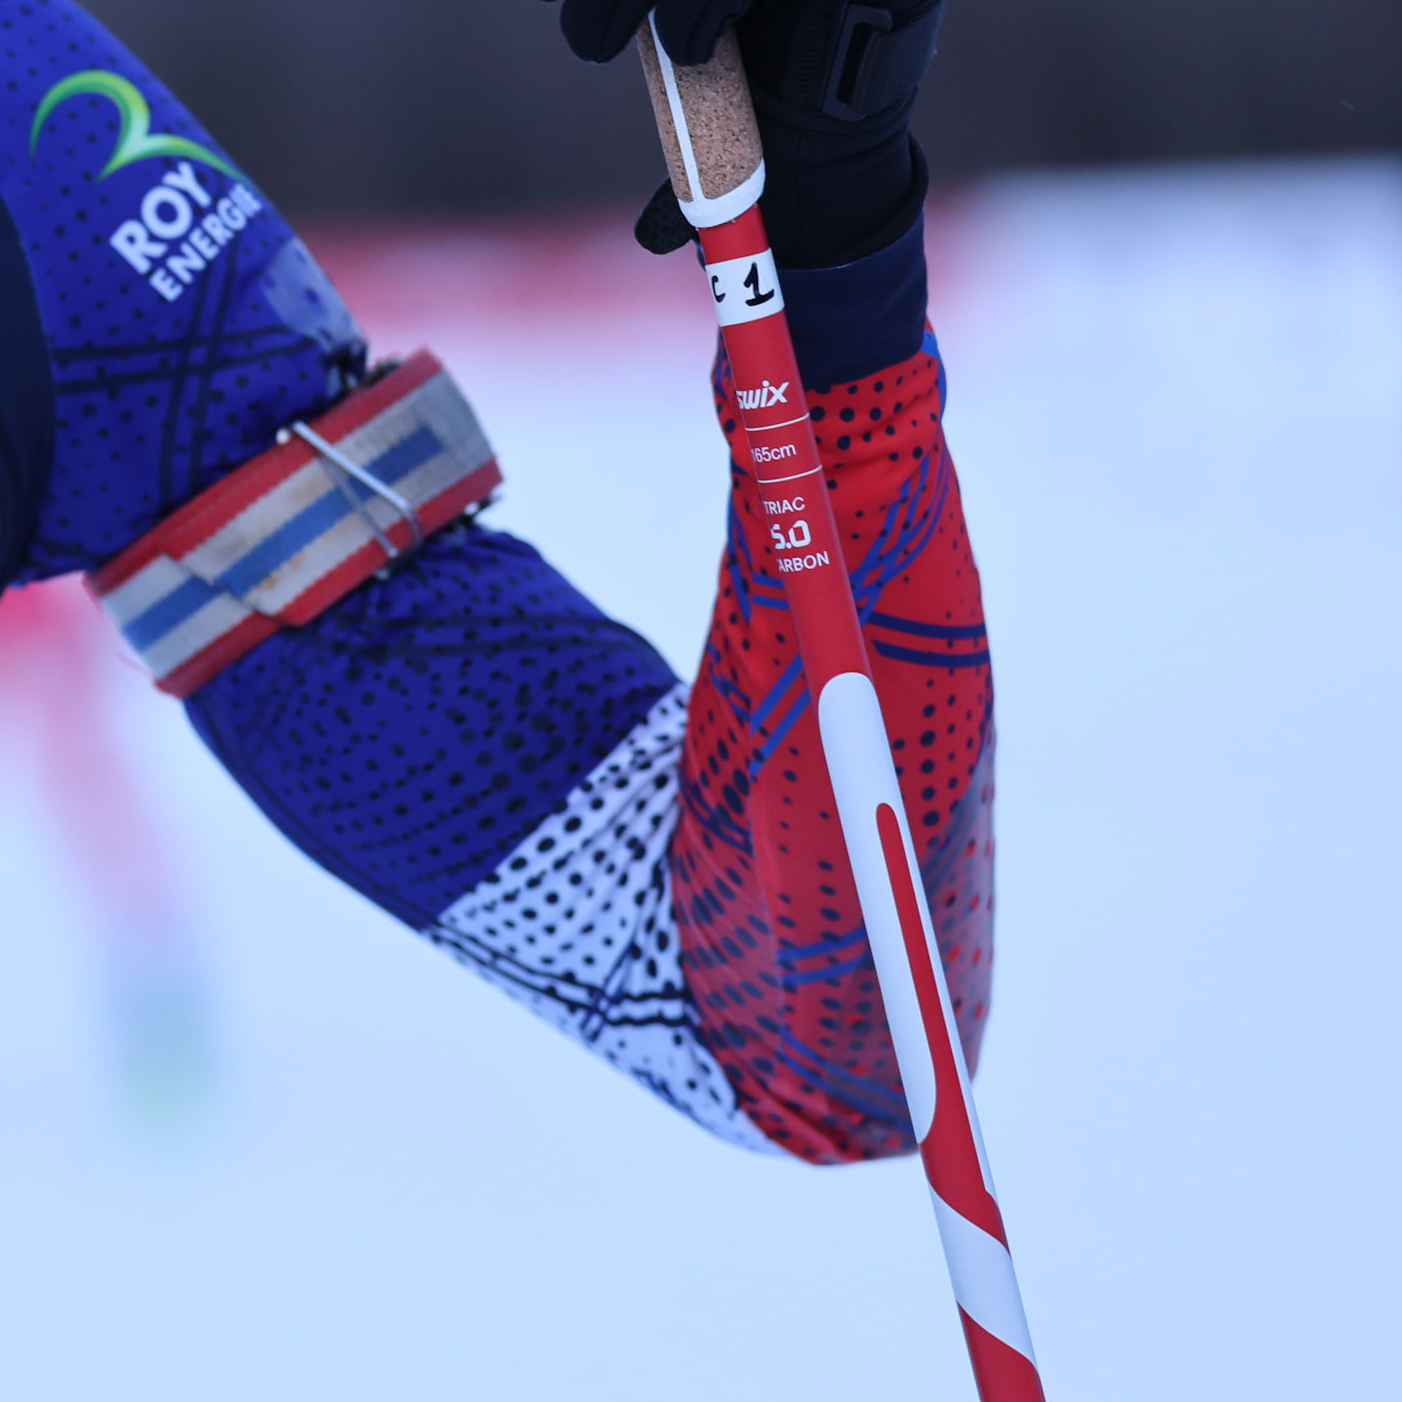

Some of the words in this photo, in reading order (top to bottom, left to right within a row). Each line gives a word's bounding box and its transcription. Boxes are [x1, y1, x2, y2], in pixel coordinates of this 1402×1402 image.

[109, 161, 212, 275] ROY
[743, 261, 775, 307] 1
[763, 496, 806, 515] TRIAC
[776, 550, 831, 573] ARBON
